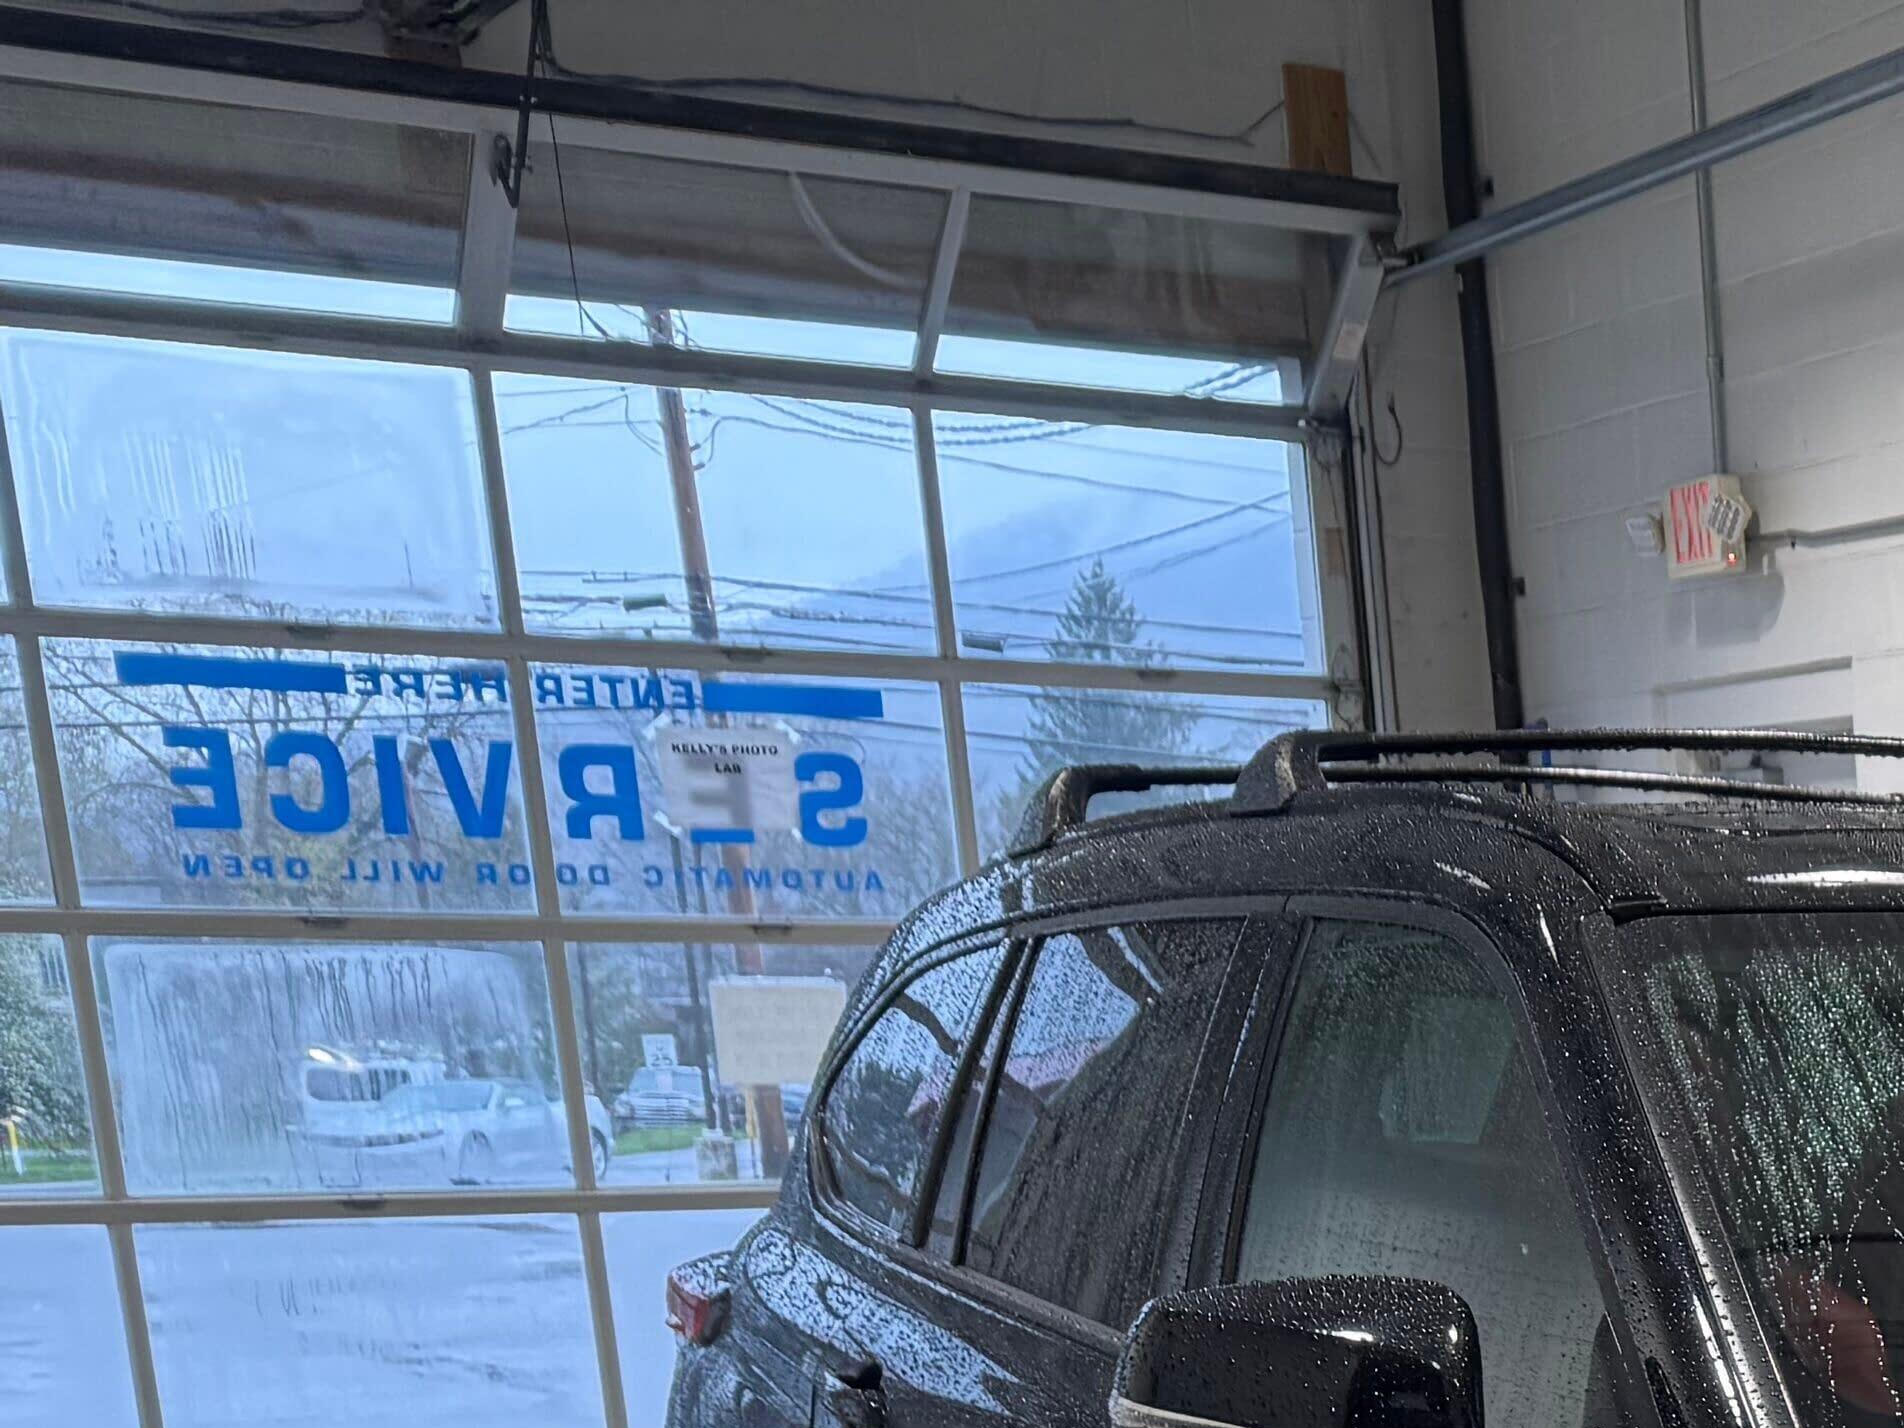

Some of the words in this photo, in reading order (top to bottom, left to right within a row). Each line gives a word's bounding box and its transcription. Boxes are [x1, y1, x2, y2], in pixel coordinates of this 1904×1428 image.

[731, 744, 779, 756] PHOTO
[714, 762, 742, 774] LAB
[650, 1054, 674, 1067] 25
